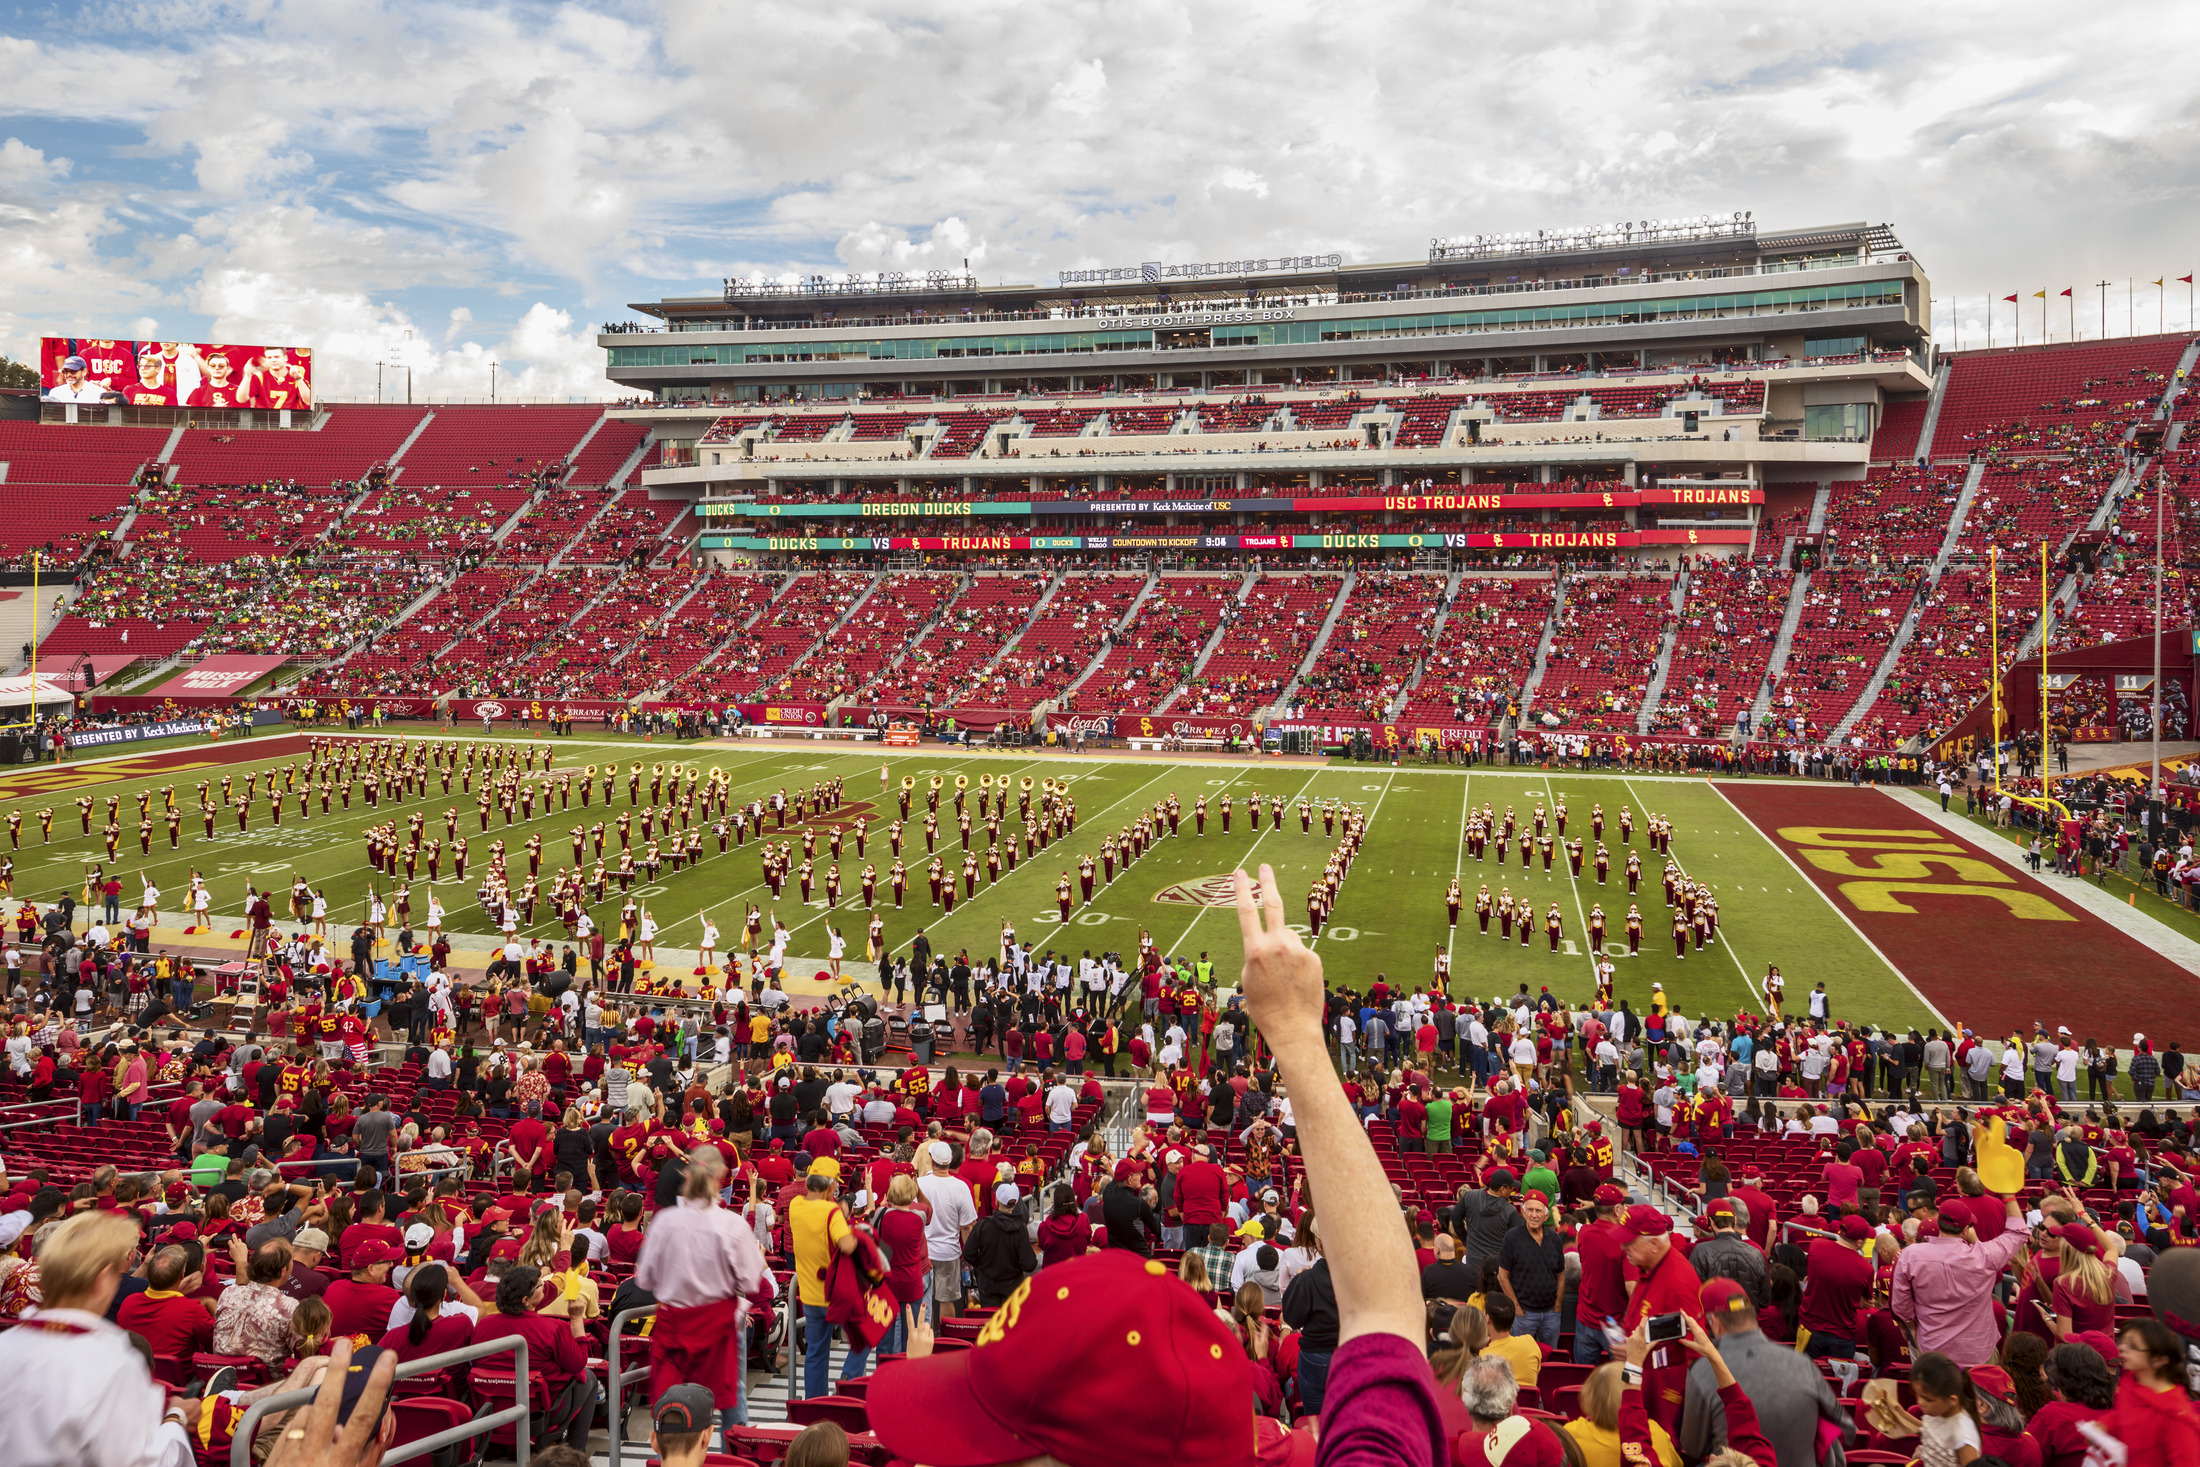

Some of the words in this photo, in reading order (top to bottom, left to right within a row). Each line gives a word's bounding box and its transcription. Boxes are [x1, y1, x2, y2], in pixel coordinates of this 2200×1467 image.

[1058, 267, 1137, 283] UNITED
[1166, 259, 1268, 277] AIRLINES
[1280, 254, 1342, 270] FIELD
[1098, 318, 1133, 329] OTIS
[1141, 315, 1195, 327] BOOTH
[1203, 312, 1254, 323] PRESS
[1262, 309, 1295, 321] BOX
[91, 358, 124, 374] USC
[1385, 496, 1417, 510] USC
[1423, 495, 1501, 509] TROJANS
[1672, 489, 1750, 503] TROJANS
[705, 503, 735, 516] DUCKS
[862, 502, 920, 516] OREGON
[924, 502, 972, 516] DUCKS
[1090, 503, 1136, 512] PRESENTED
[1138, 503, 1149, 511] BY
[1153, 502, 1171, 511] Keck
[1172, 502, 1204, 511] Medicine
[1204, 502, 1214, 511] of
[1213, 501, 1232, 511] USC
[769, 537, 818, 550] DUCKS
[872, 537, 890, 549] VS
[941, 537, 1011, 549] TROJANS
[1052, 539, 1074, 547] DUCKS
[1112, 538, 1157, 547] COUNTDOWN
[1158, 538, 1168, 547] TO
[1168, 538, 1198, 547] KICKOFF
[1245, 538, 1276, 546] TROJANS
[1323, 535, 1379, 548] DUCKS
[1444, 534, 1466, 547] VS
[1529, 533, 1617, 547] TROJANS
[183, 670, 263, 680] MUSCLE
[0, 683, 52, 694] udi
[182, 680, 236, 688] MILK
[2122, 676, 2138, 689] 11
[2133, 717, 2145, 726] 42
[70, 731, 123, 746] RESENTED
[124, 728, 138, 739] BY
[143, 726, 165, 737] Keck
[1441, 728, 1484, 739] CREDIT
[1776, 826, 2081, 922] USC
[1032, 909, 1111, 926] 30
[1183, 993, 1197, 1007] 25
[321, 1019, 337, 1033] 55
[342, 1020, 354, 1033] 42
[433, 1032, 446, 1046] 14
[282, 1073, 300, 1092] 55
[908, 1077, 928, 1096] 55
[1176, 1076, 1190, 1091] 14
[1683, 1106, 1690, 1122] 2
[1710, 1110, 1719, 1129] 4
[624, 1137, 638, 1160] 2
[1597, 1143, 1613, 1168] 55
[738, 1437, 792, 1447] www.trojanseats.co
